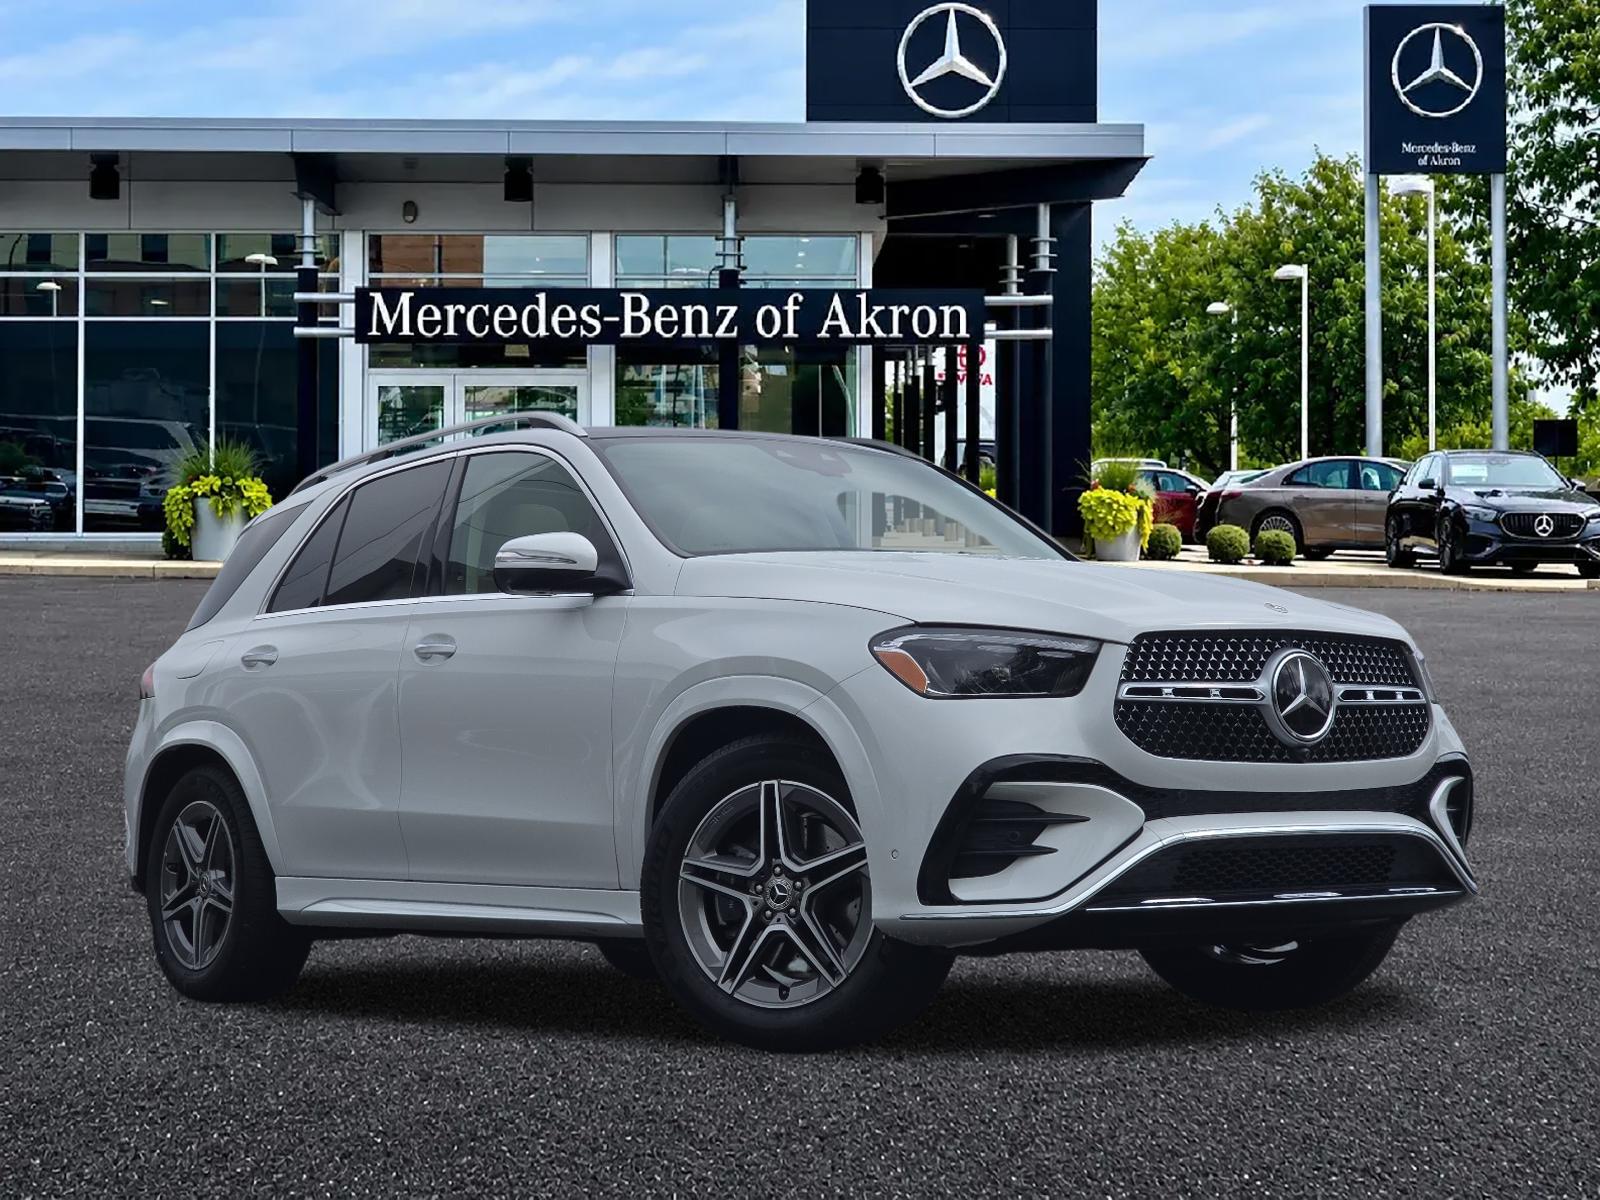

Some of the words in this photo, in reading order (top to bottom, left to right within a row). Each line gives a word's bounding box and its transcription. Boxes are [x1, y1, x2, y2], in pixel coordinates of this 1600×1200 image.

[1401, 142, 1476, 153] Mercedes-Benz
[1417, 154, 1428, 166] of
[1430, 154, 1461, 166] Akron
[367, 292, 738, 338] Mercedes-Benz
[756, 292, 804, 338] of
[816, 293, 970, 338] Akron
